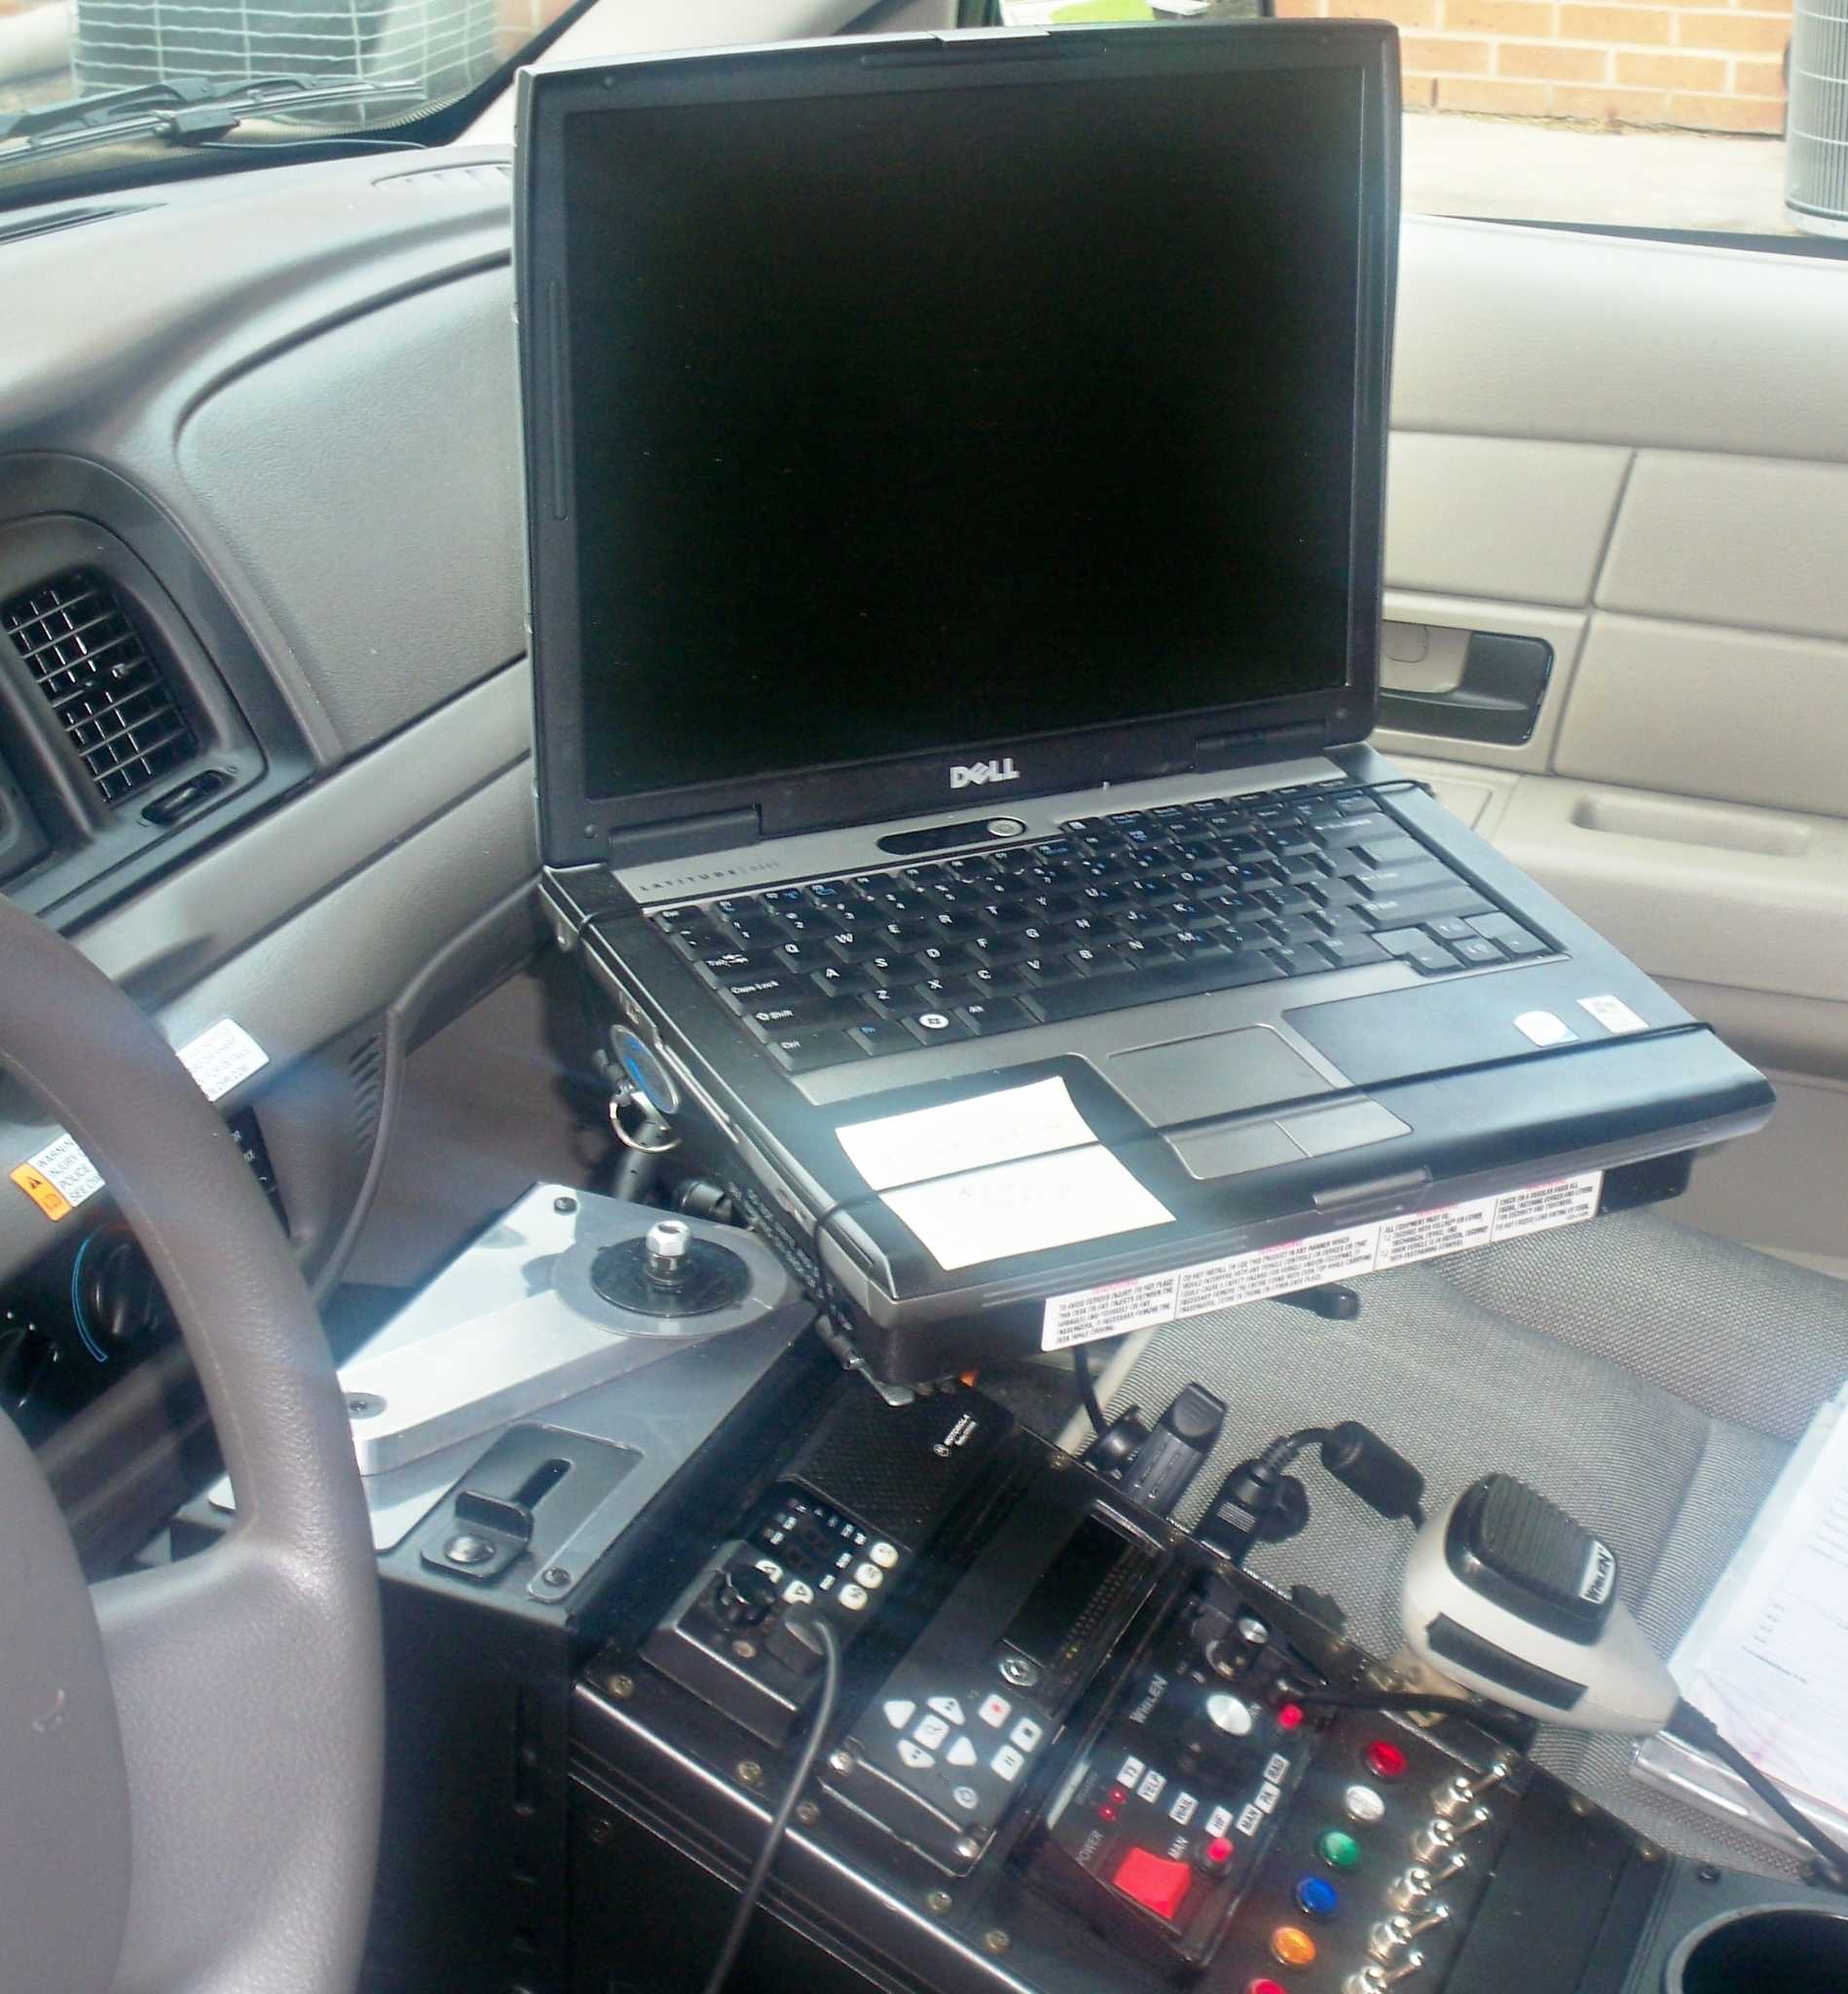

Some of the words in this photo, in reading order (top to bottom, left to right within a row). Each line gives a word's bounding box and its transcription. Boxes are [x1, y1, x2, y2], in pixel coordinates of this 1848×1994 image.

[950, 757, 1020, 789] DELL
[785, 943, 801, 954] Q
[834, 933, 855, 944] W
[887, 924, 902, 935] E
[938, 913, 953, 924] R
[1084, 888, 1100, 898] U
[826, 968, 841, 979] A
[874, 958, 889, 968] S
[926, 948, 942, 958] D
[977, 938, 989, 948] F
[1075, 918, 1090, 929] H
[874, 989, 891, 1001] Z
[928, 979, 944, 990] X
[977, 969, 992, 979] C
[1027, 959, 1041, 971] V
[1128, 941, 1145, 951] N
[38, 1138, 76, 1167] WARNIN
[1128, 1672, 1168, 1724] WHELEN
[1074, 1829, 1104, 1866] POWER
[1168, 1834, 1190, 1862] MAN
